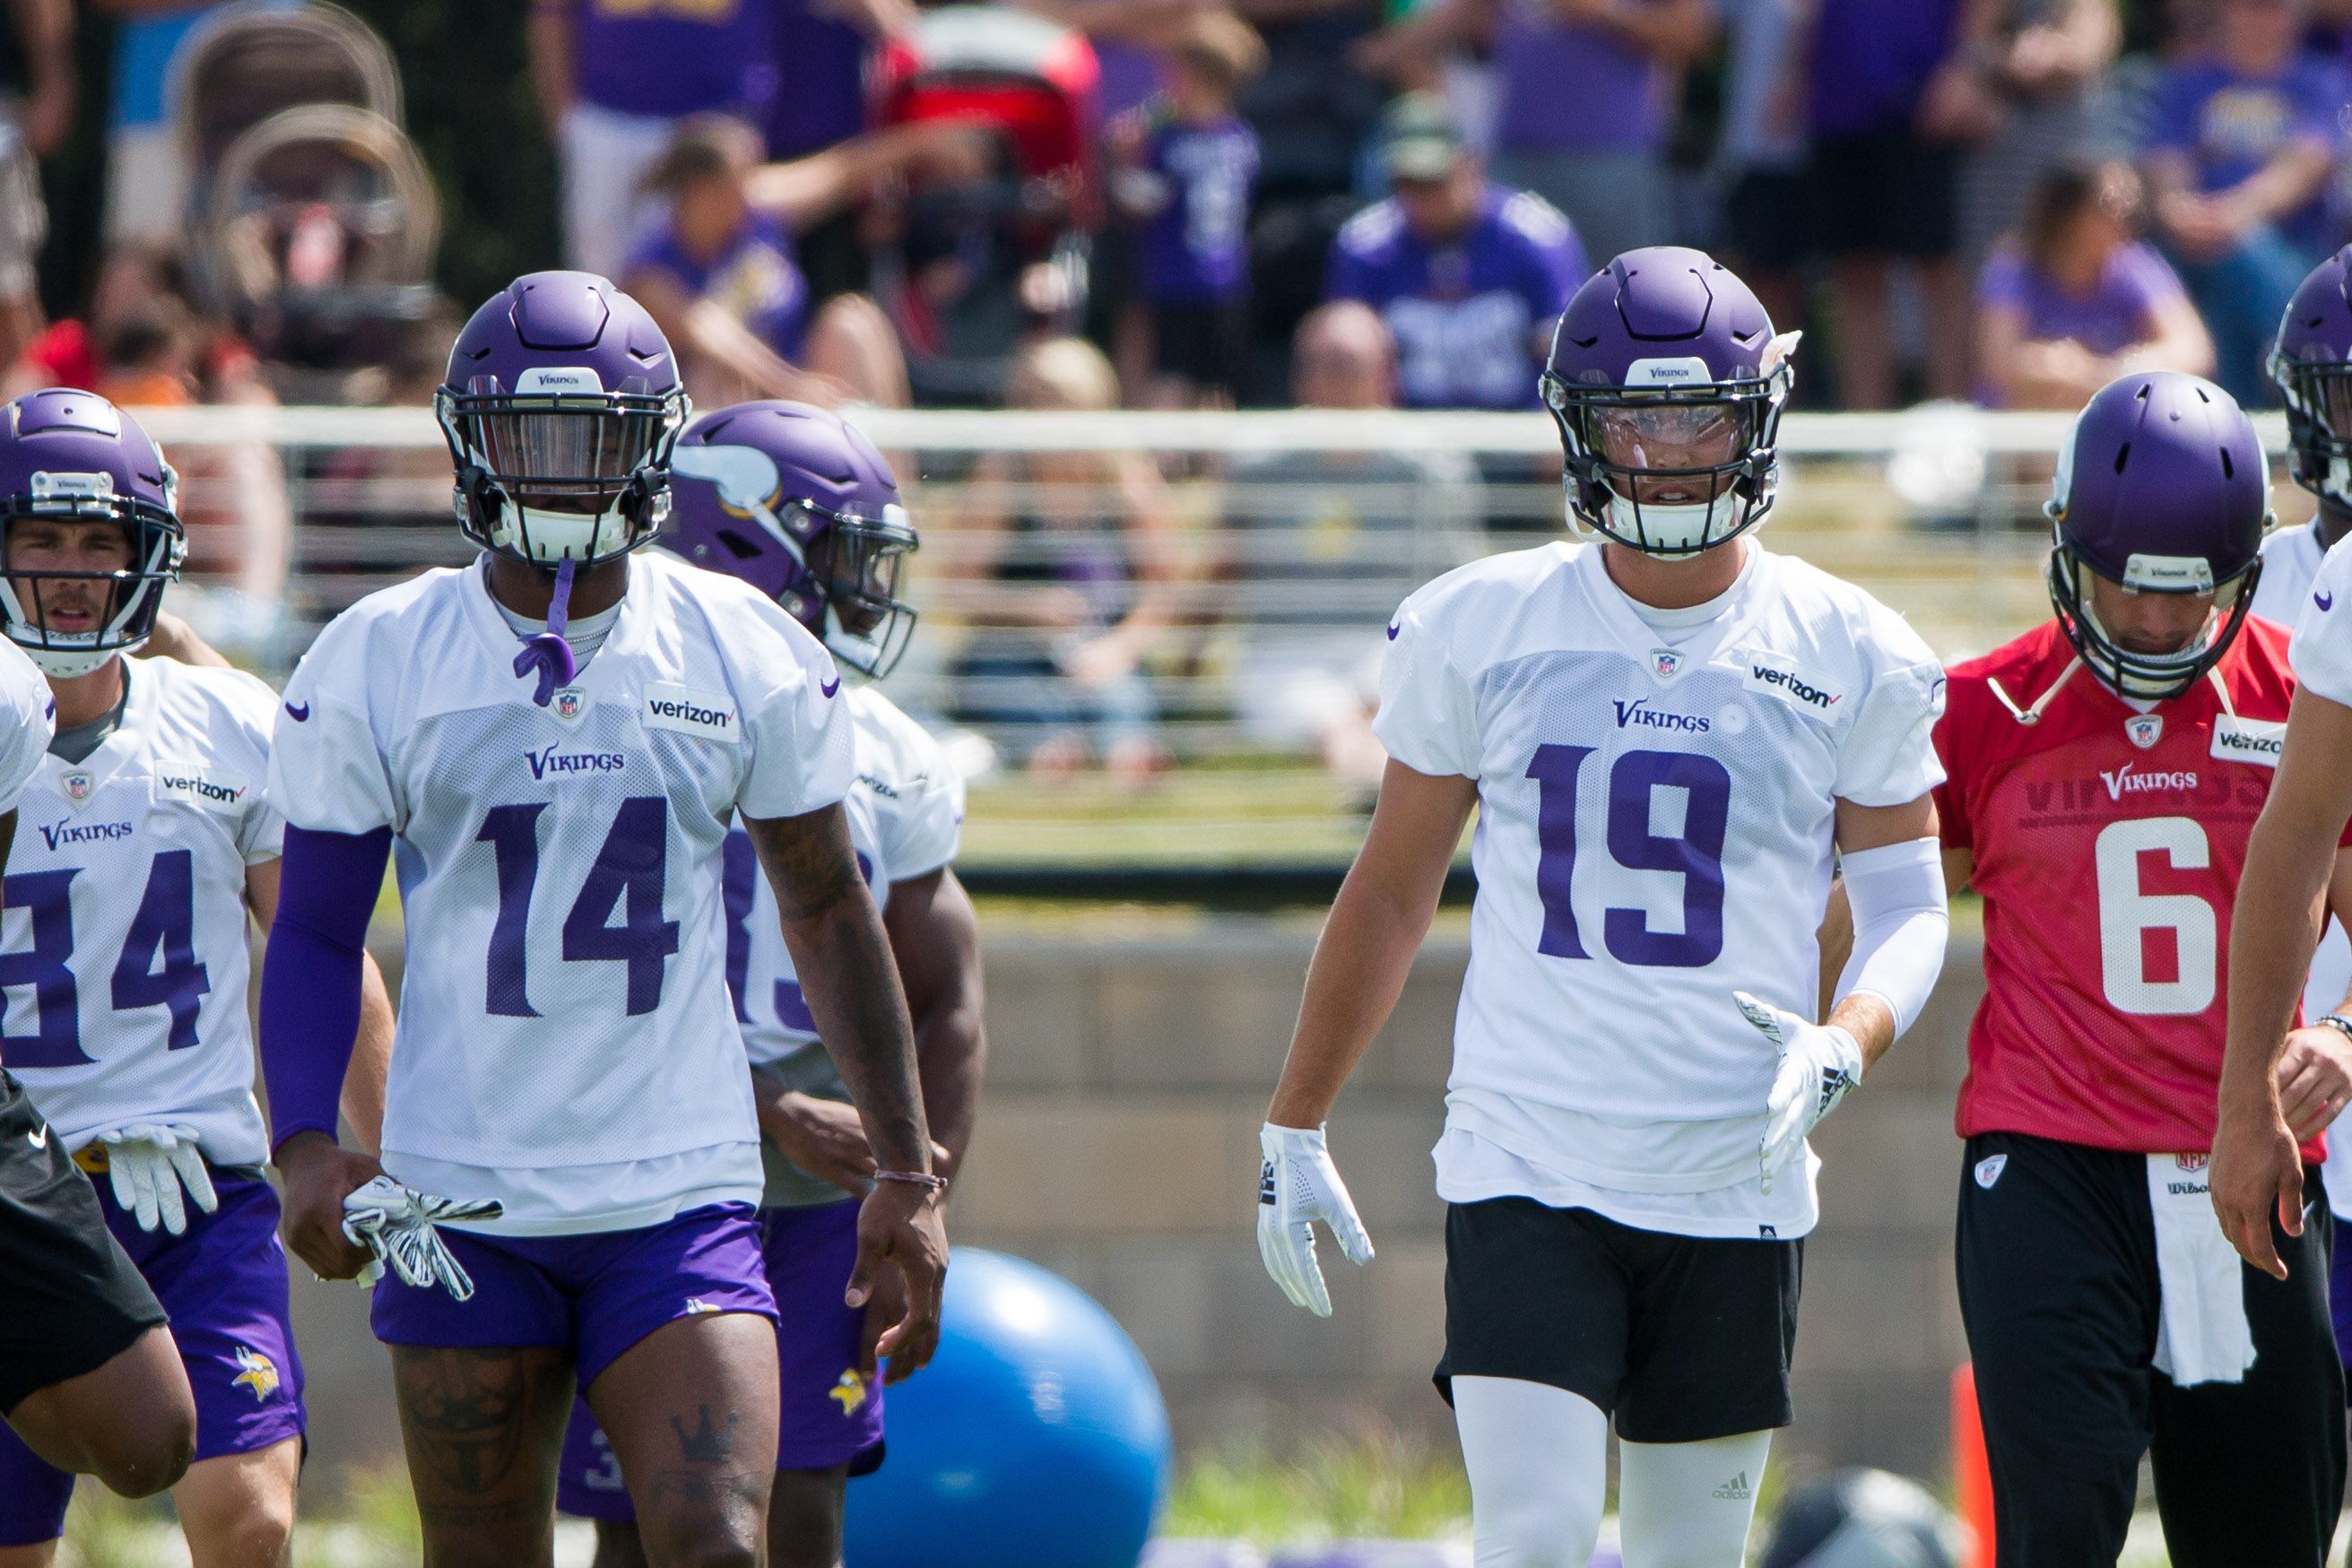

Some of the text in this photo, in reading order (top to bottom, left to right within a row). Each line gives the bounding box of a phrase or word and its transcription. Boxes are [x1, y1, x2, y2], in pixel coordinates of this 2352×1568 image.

[1752, 665, 1829, 708] verizon
[649, 699, 727, 728] verizon
[162, 776, 236, 803] verizon
[1524, 743, 1731, 967] 19
[474, 795, 680, 1018] 14
[2095, 817, 2217, 1016] 6
[2167, 1182, 2209, 1195] Wilso
